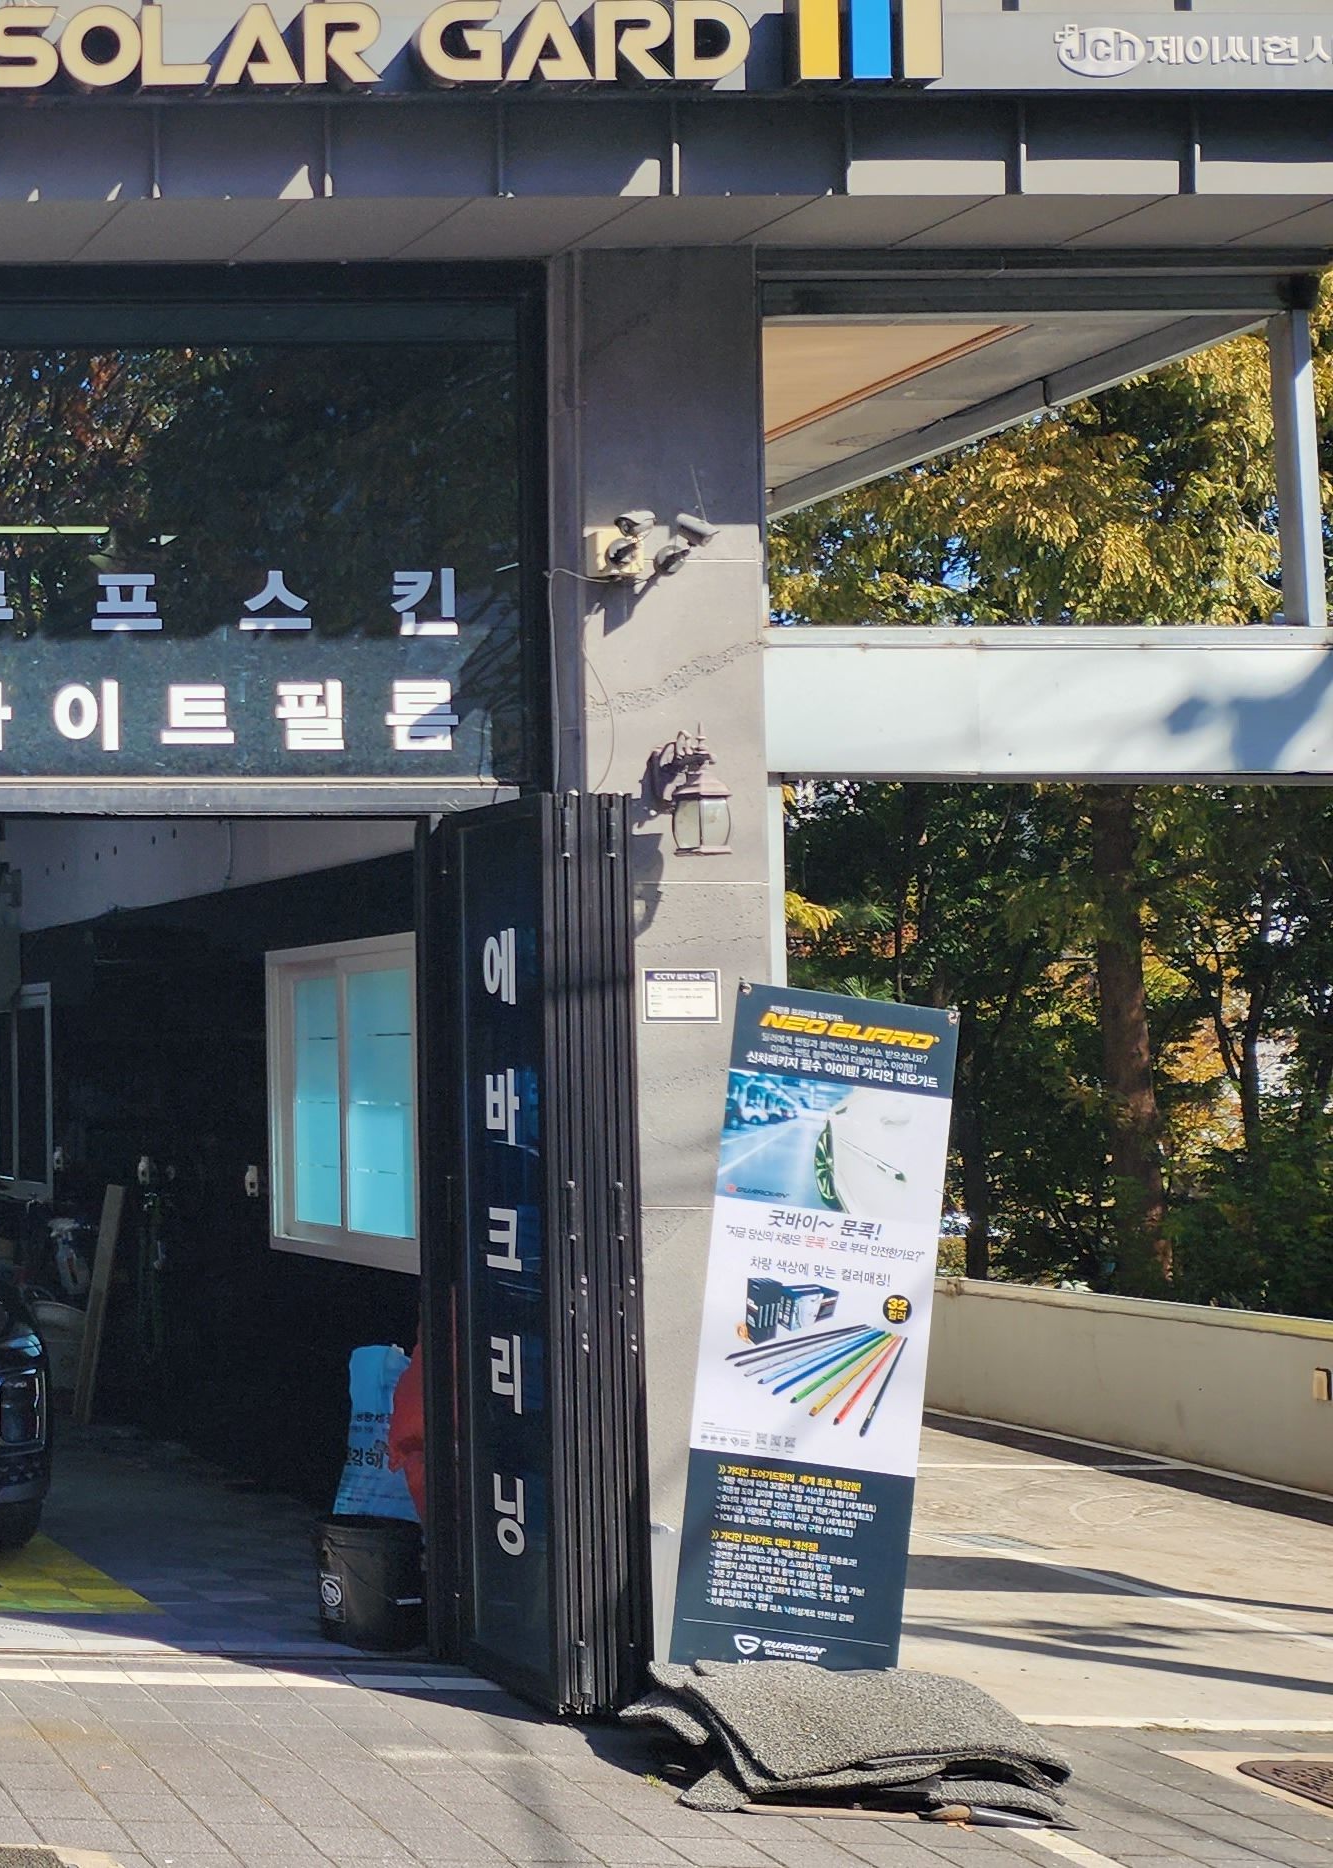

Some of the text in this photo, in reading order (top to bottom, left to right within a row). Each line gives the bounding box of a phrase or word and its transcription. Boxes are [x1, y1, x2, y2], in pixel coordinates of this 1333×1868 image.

[420, 1, 750, 83] GARD
[1146, 35, 1300, 65] 제이씨현
[761, 1012, 828, 1035] NEO
[864, 1068, 893, 1081] 가디언
[898, 1073, 939, 1088] 네오가드
[841, 1220, 882, 1240] 문콕!
[750, 1257, 891, 1286] 차량 색상에 맞는 컬러매칭!
[888, 1299, 909, 1310] 32
[888, 1310, 907, 1321] 컬러
